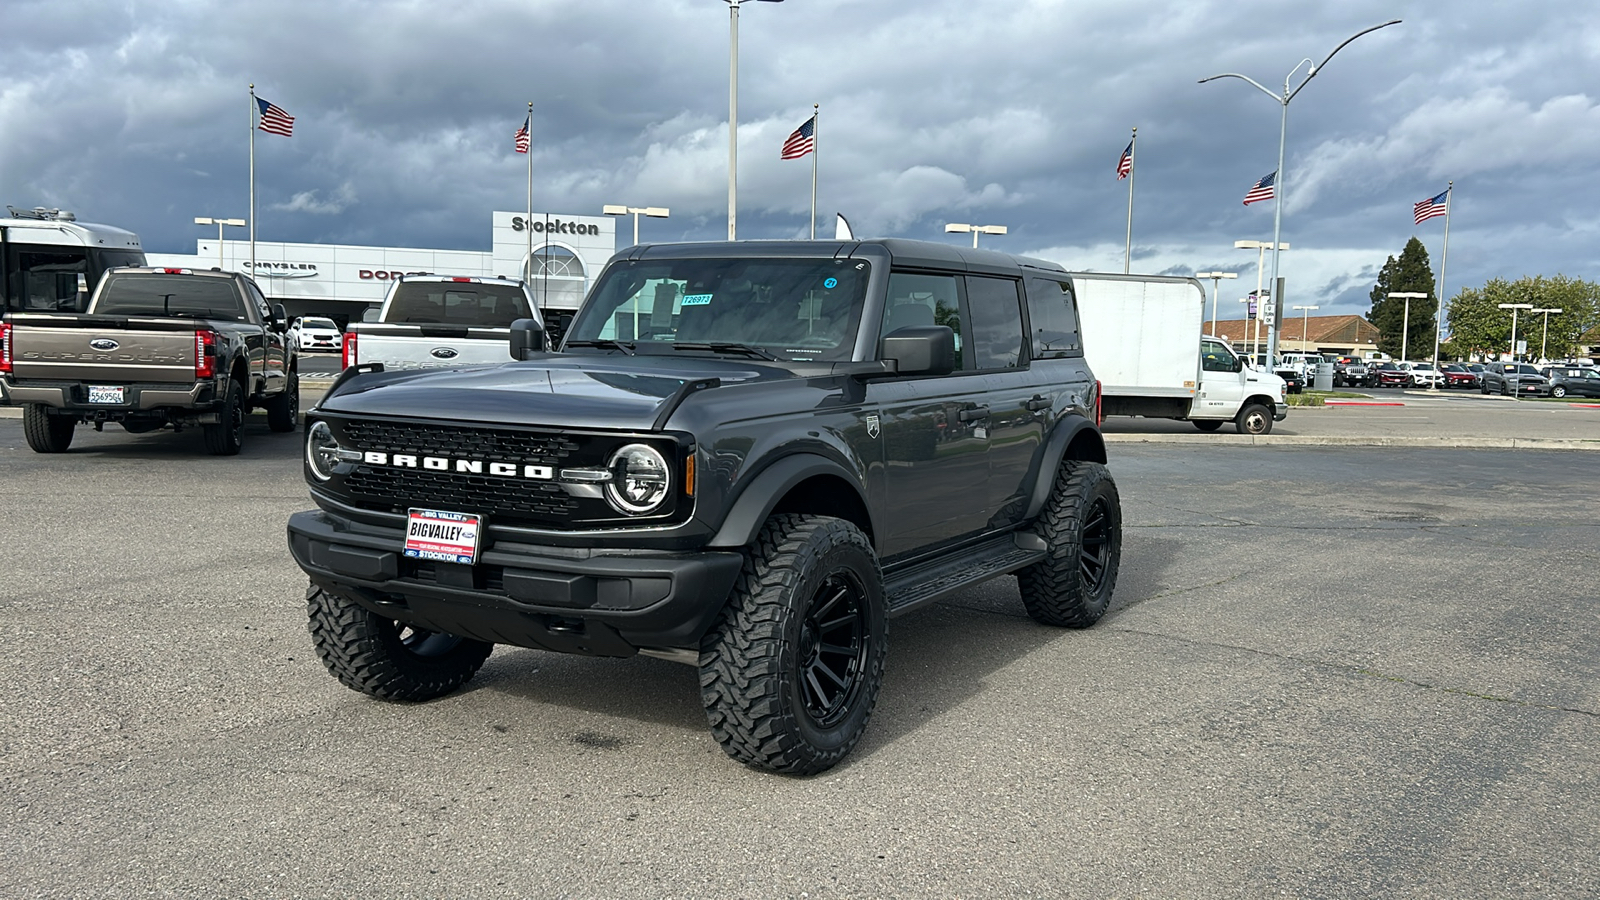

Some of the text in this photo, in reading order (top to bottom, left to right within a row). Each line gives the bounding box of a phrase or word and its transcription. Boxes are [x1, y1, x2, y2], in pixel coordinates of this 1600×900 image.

[242, 261, 317, 270] CHRYSLER
[364, 451, 553, 479] BRONCO
[438, 512, 463, 522] VALLEY
[409, 522, 463, 541] BIGVALLEY
[418, 550, 458, 562] STOCKTON
